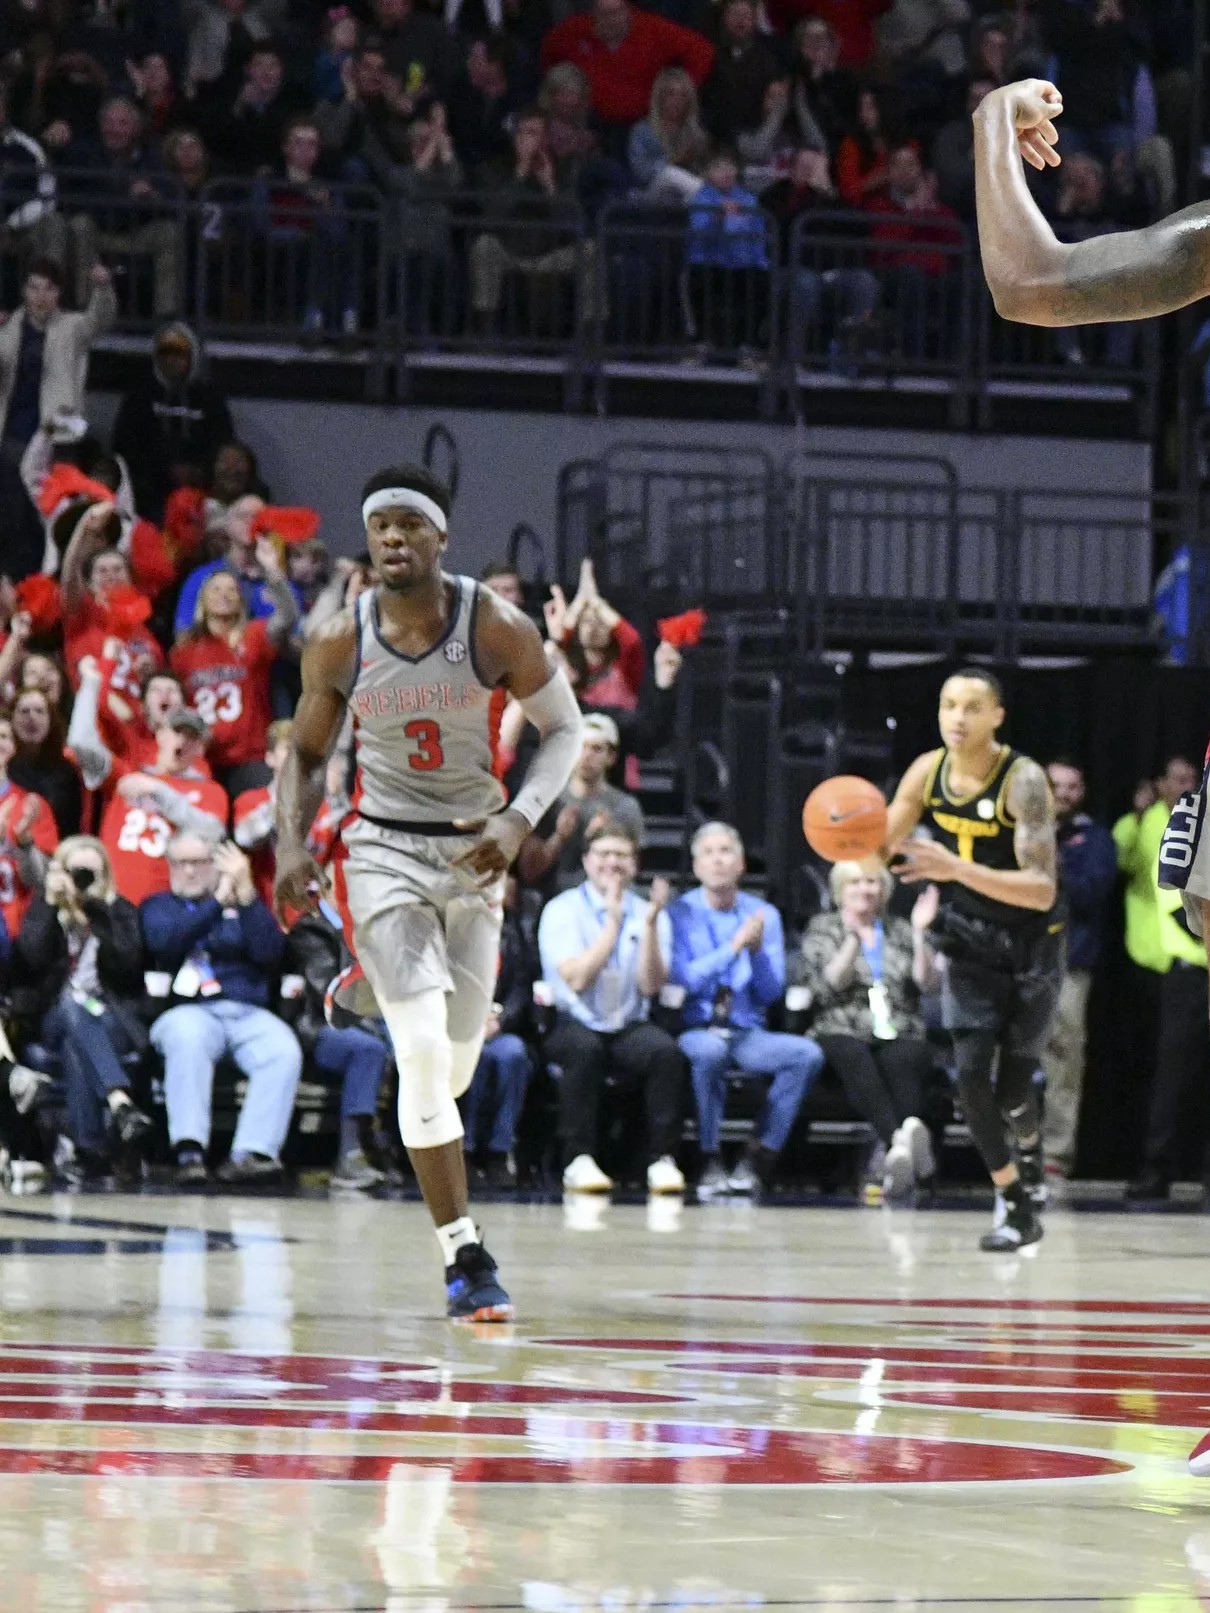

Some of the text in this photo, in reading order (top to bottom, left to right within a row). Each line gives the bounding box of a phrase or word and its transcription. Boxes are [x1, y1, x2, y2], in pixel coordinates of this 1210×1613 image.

[355, 683, 483, 718] REBELS
[404, 719, 444, 771] 3
[118, 808, 170, 858] 23
[1160, 794, 1201, 868] OLE
